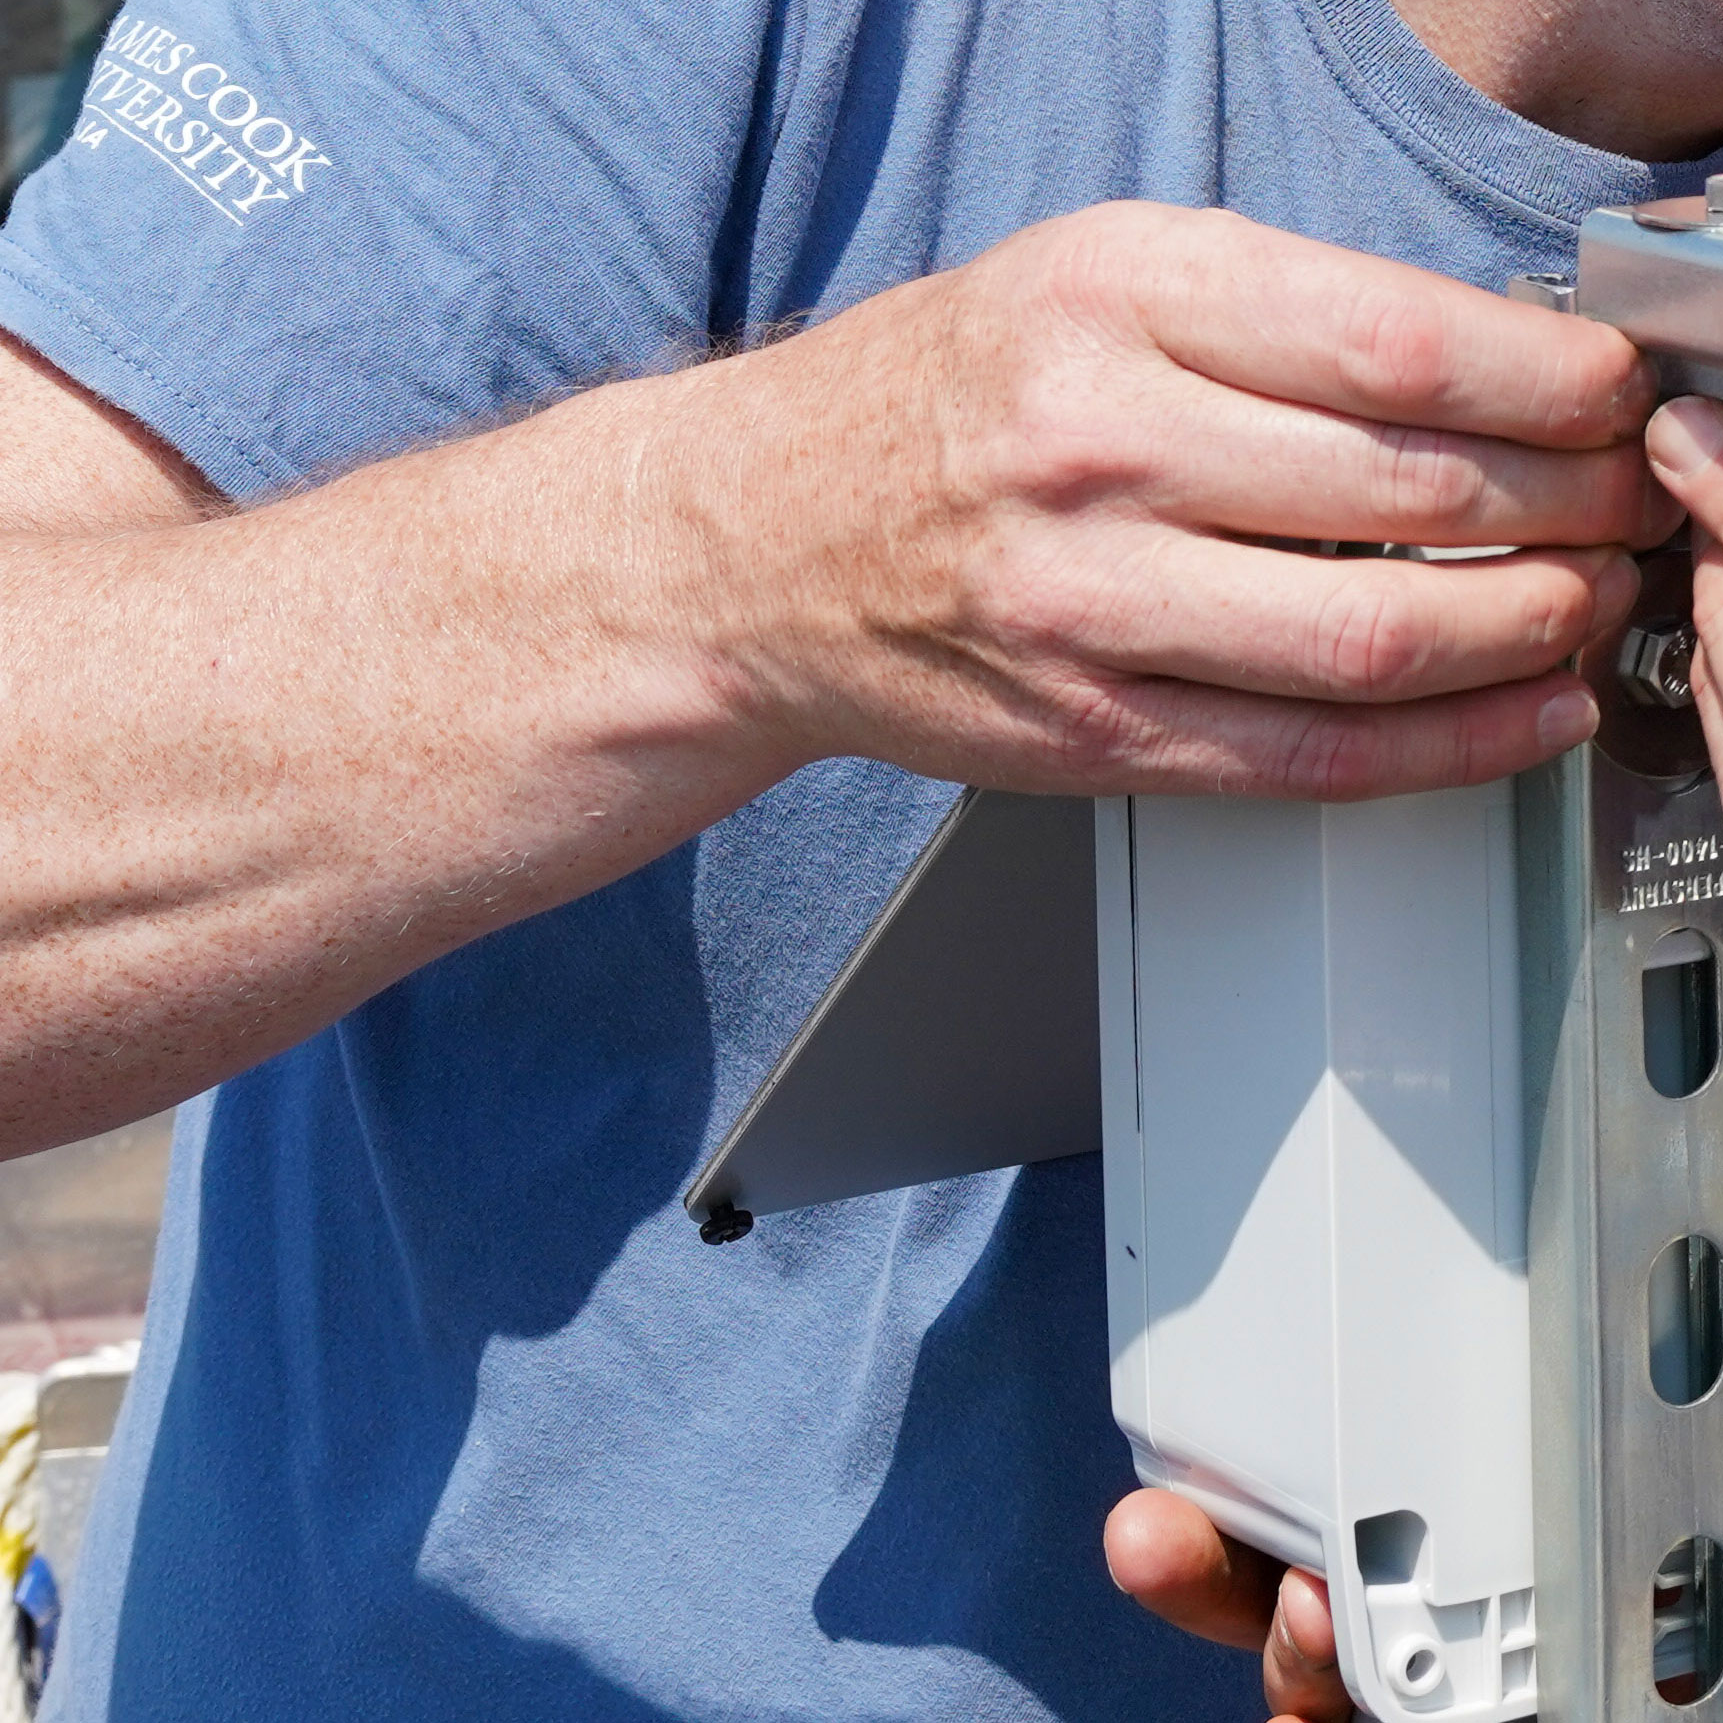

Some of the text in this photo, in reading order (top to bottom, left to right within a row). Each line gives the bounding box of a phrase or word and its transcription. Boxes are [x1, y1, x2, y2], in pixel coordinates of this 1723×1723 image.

[87, 60, 290, 215] IVERSITY
[105, 15, 333, 193] AMES COOK
